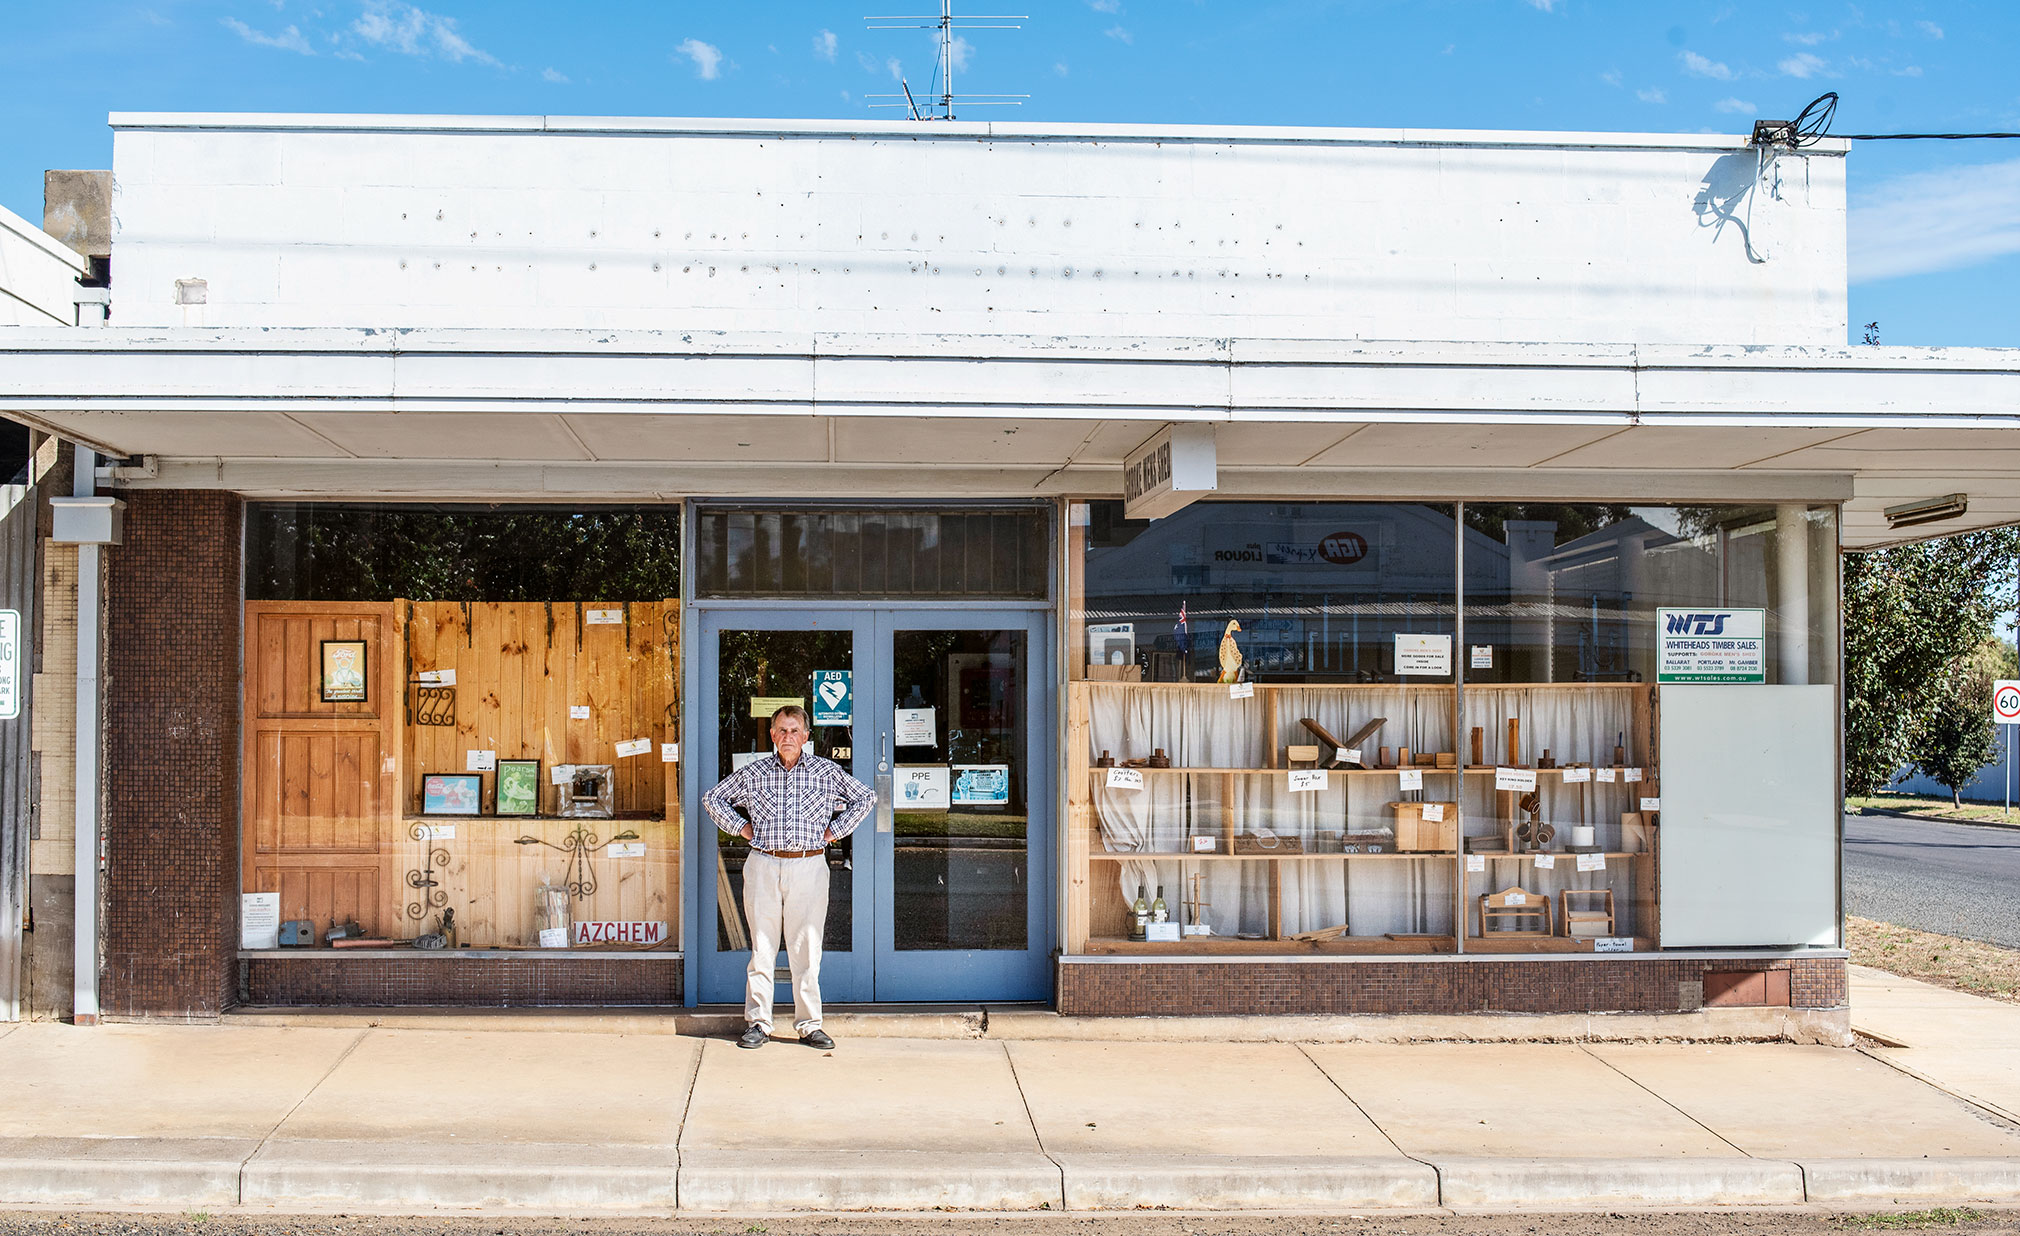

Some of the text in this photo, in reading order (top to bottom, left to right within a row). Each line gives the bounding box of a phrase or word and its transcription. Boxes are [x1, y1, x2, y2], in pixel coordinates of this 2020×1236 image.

[1665, 614, 1731, 635] WTS
[1667, 641, 1710, 649] WHITEHEADS
[1712, 641, 1735, 649] TIMBER
[824, 672, 842, 680] AED
[2000, 695, 2019, 709] 60
[833, 747, 849, 759] 21
[911, 772, 930, 780] PPE
[579, 922, 659, 942] AZCHEM
